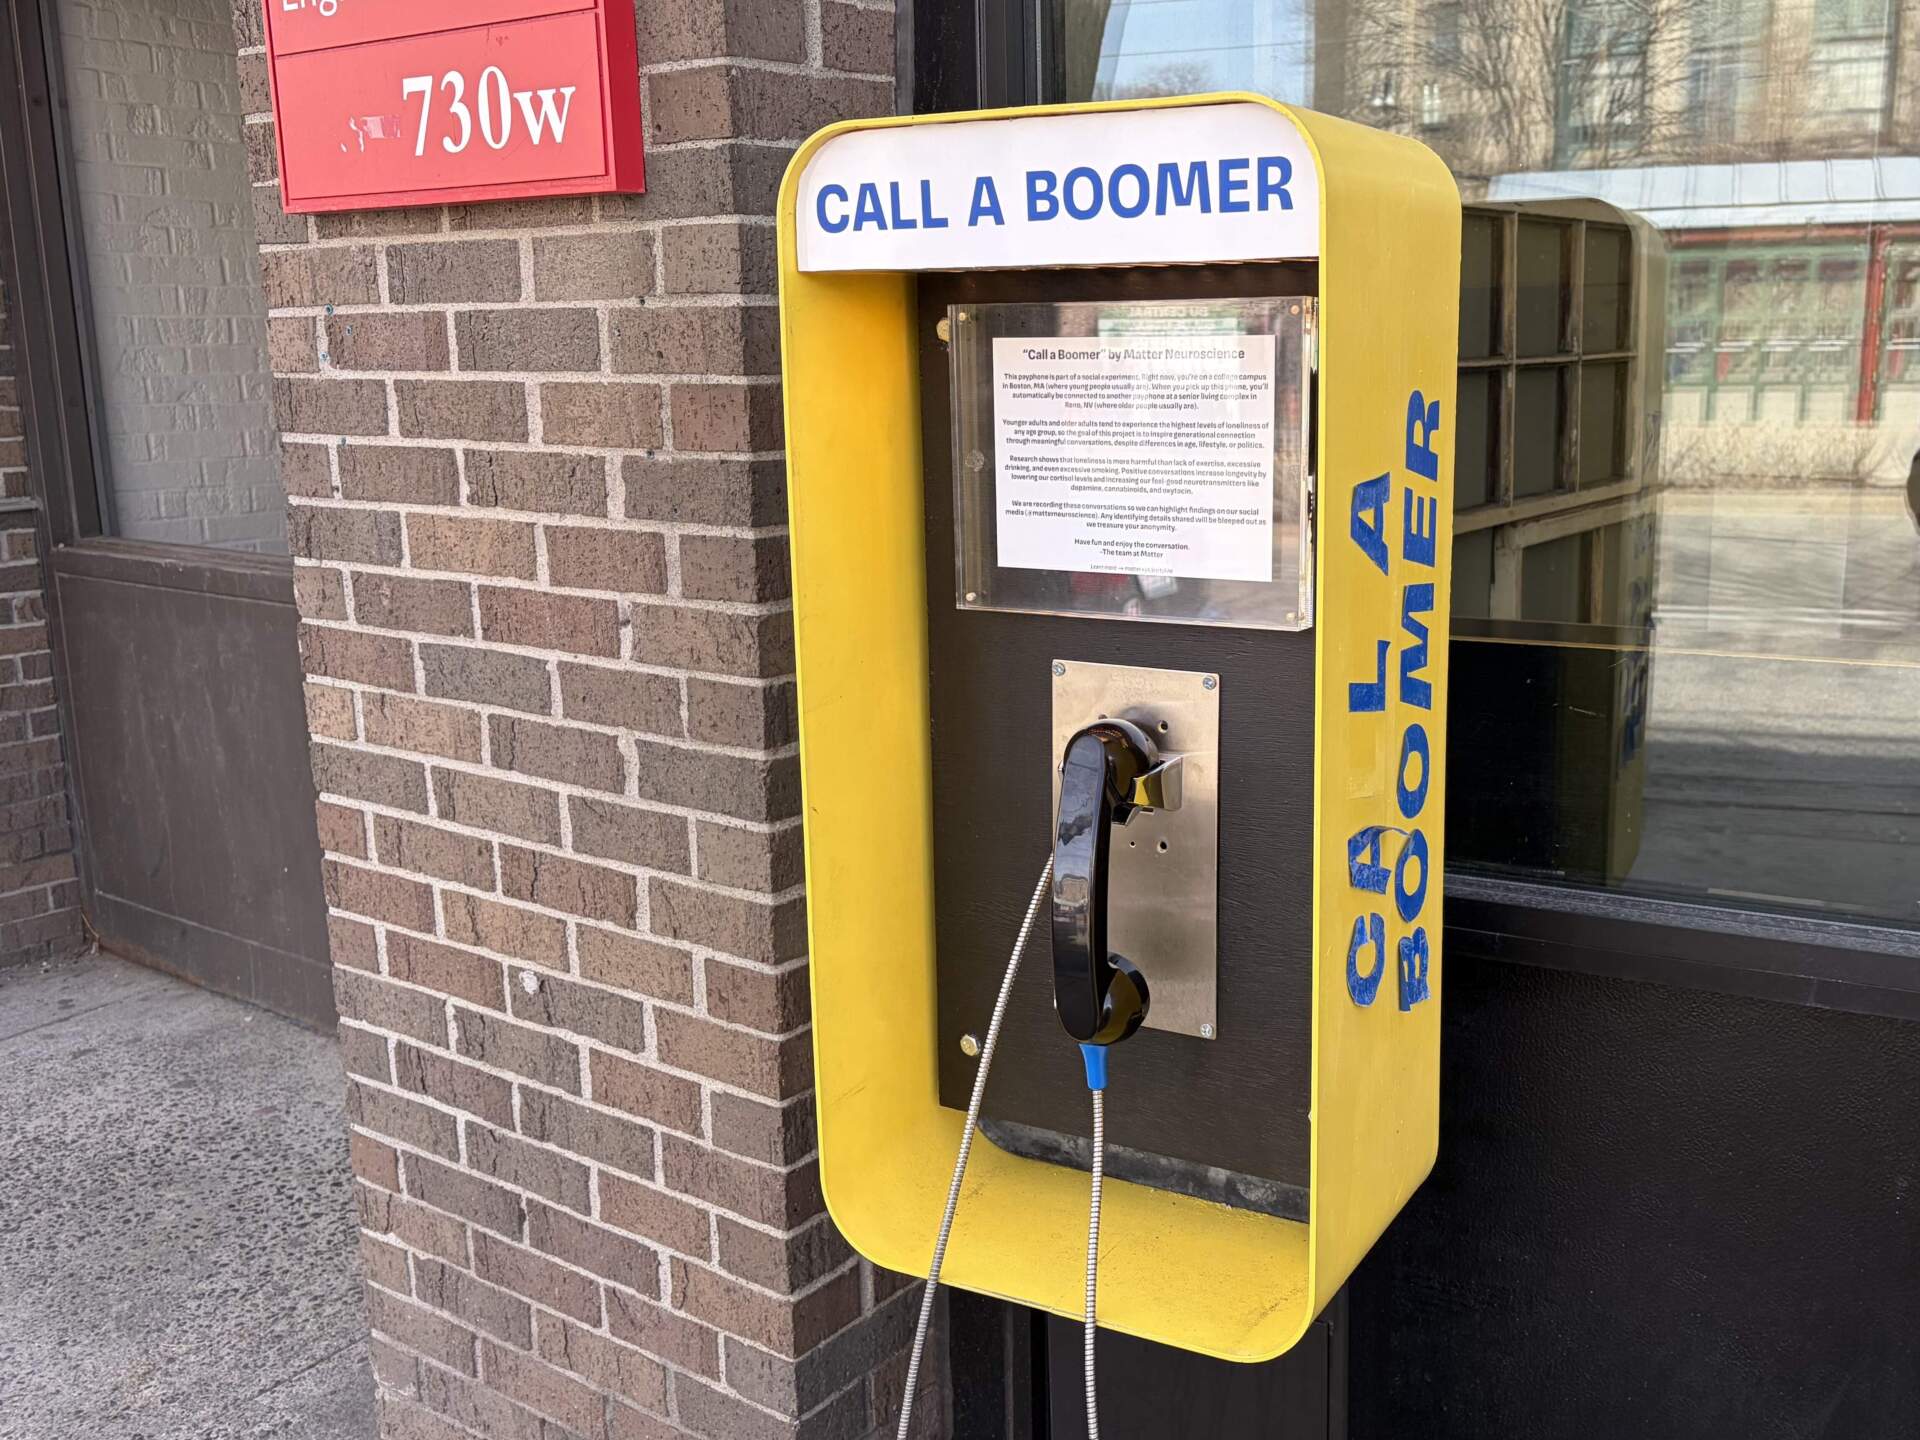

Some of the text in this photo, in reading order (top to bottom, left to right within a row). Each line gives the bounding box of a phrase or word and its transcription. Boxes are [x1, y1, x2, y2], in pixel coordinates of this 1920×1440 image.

[402, 65, 577, 157] 730w
[816, 155, 1294, 234] CALL A BOOMER
[1108, 349, 1121, 361] by
[1124, 349, 1163, 360] Matter
[1165, 349, 1245, 359] Neuroscience
[1018, 373, 1048, 381] payphone
[1056, 373, 1069, 381] part
[1046, 383, 1068, 391] (where
[1089, 383, 1110, 391] people
[1185, 383, 1200, 391] pick
[1012, 392, 1055, 400] automatically
[1132, 392, 1165, 401] payphone
[1200, 393, 1219, 401] living
[1094, 402, 1117, 410] (where
[1135, 402, 1158, 410] people
[1002, 419, 1028, 427] Younger
[1122, 421, 1158, 429] experience
[1171, 421, 1196, 430] highest
[1077, 429, 1090, 438] goal
[1112, 430, 1135, 438] project
[1150, 430, 1173, 439] inspire
[1173, 431, 1216, 440] generational
[1006, 437, 1030, 446] through
[1031, 438, 1066, 446] meaningful
[1114, 439, 1138, 448] despite
[1011, 473, 1038, 482] lowering
[1106, 476, 1139, 485] increasing
[1183, 478, 1246, 486] neurotransmitters
[1225, 470, 1257, 478] longevity
[1258, 470, 1267, 478] by
[1033, 501, 1063, 510] recording
[1081, 502, 1127, 510] conversations
[1159, 505, 1188, 514] highlight
[1188, 506, 1216, 515] findings
[1100, 512, 1113, 521] Any
[1113, 513, 1148, 522] identifying
[1217, 517, 1244, 526] bleeped
[1145, 541, 1190, 550] conversation.
[1394, 389, 1440, 1012] BOOMER
